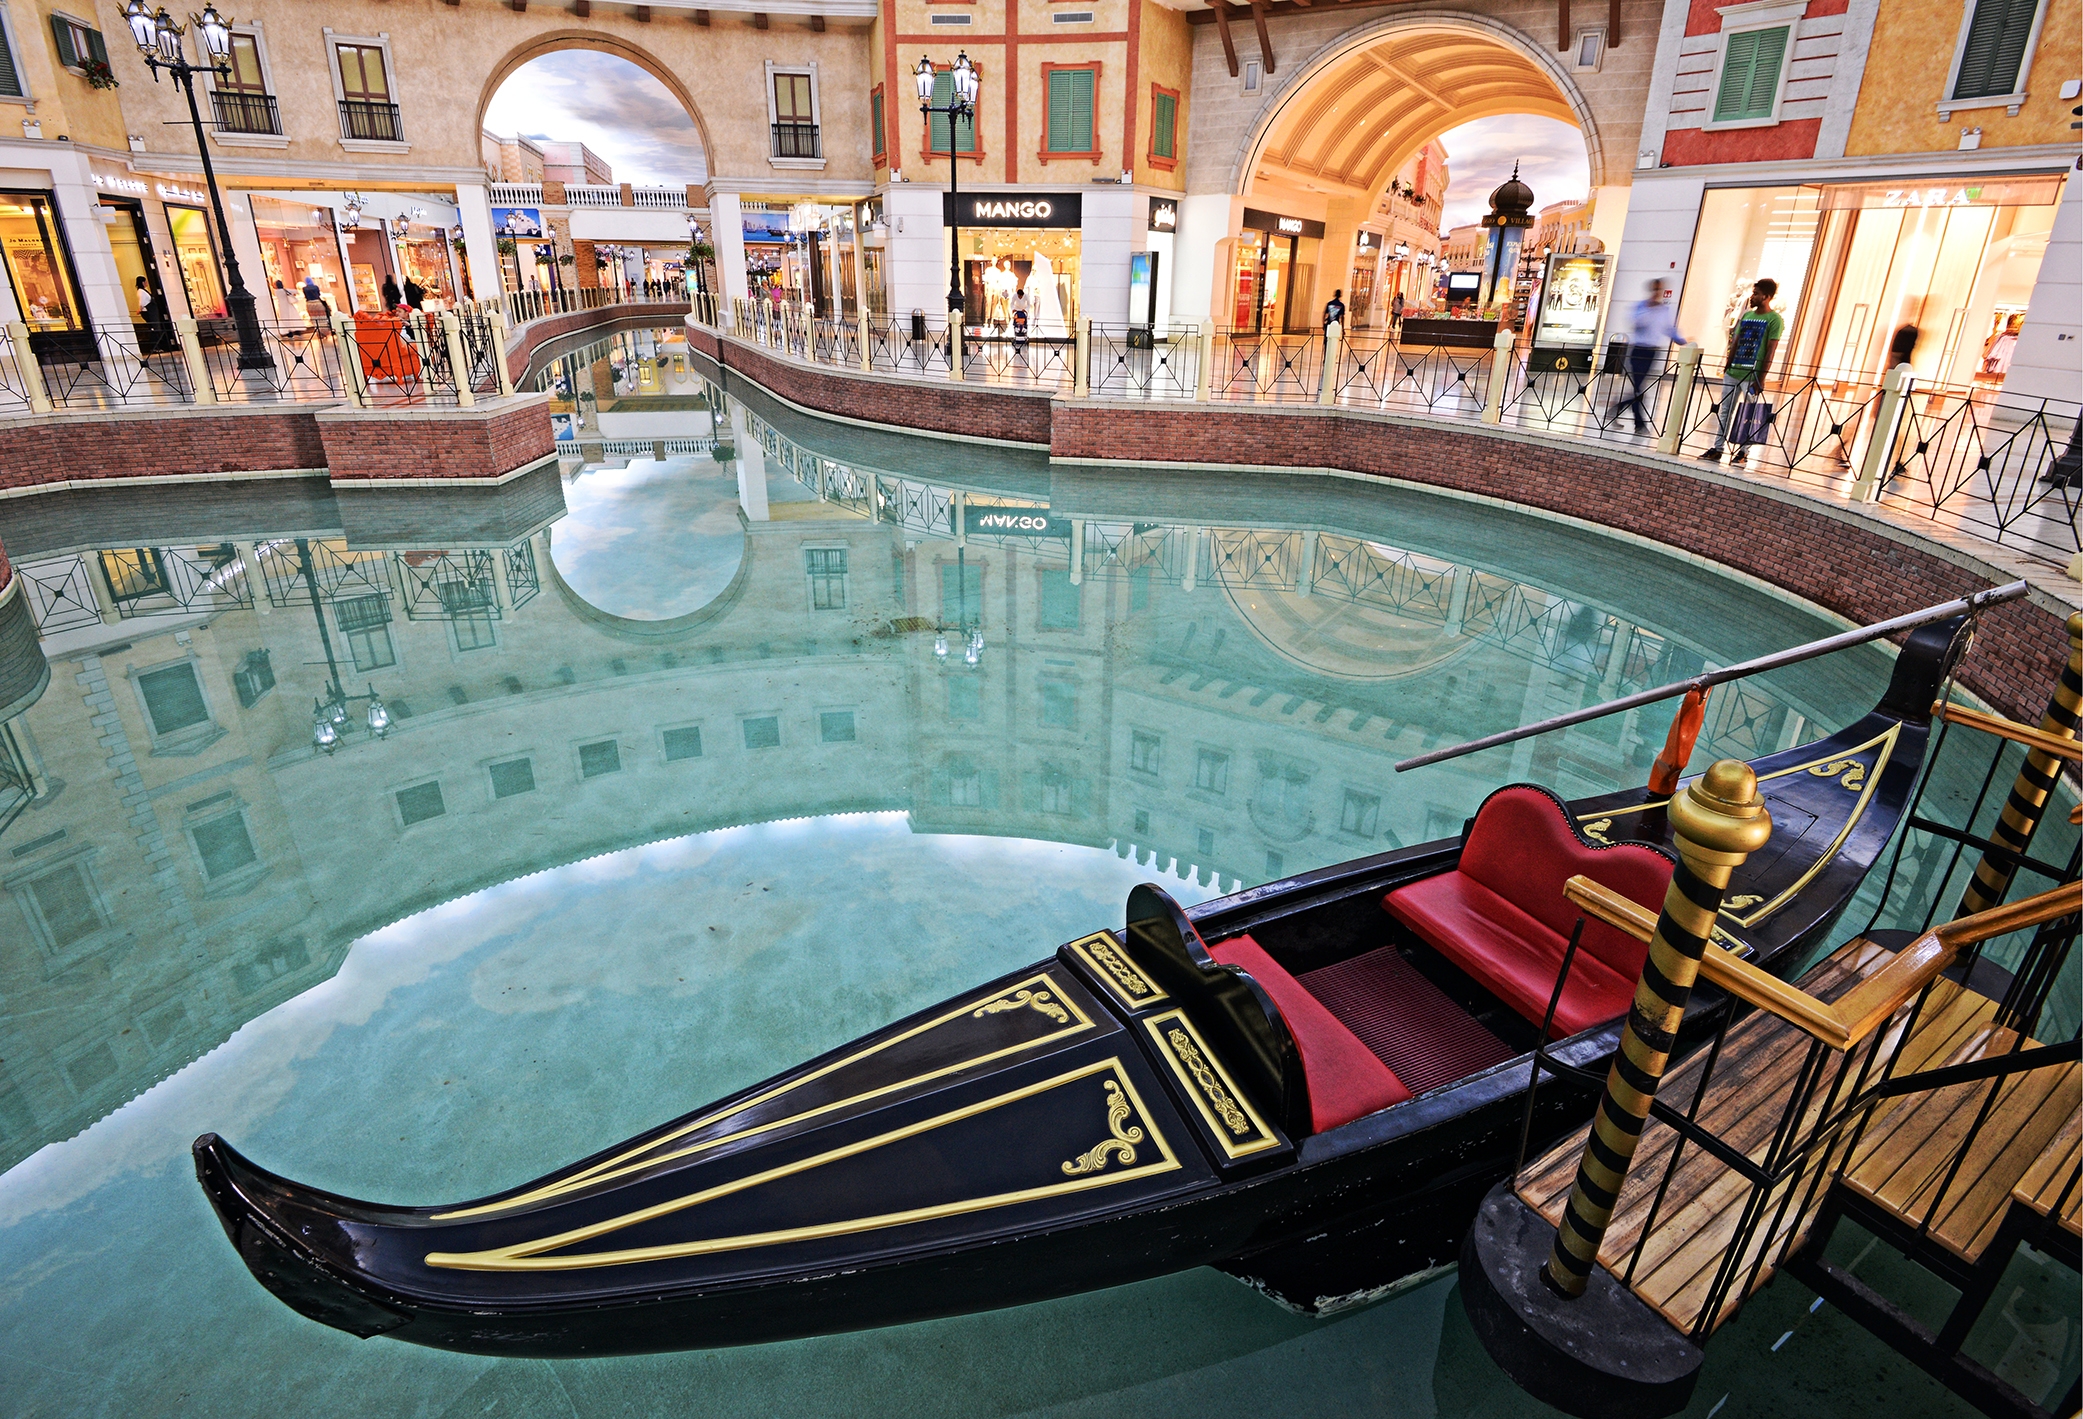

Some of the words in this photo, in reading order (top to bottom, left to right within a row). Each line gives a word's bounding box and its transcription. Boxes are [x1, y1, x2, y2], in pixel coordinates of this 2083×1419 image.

[1884, 188, 1971, 206] ZARA
[975, 201, 1052, 218] MANGO
[1278, 217, 1302, 233] MANGO
